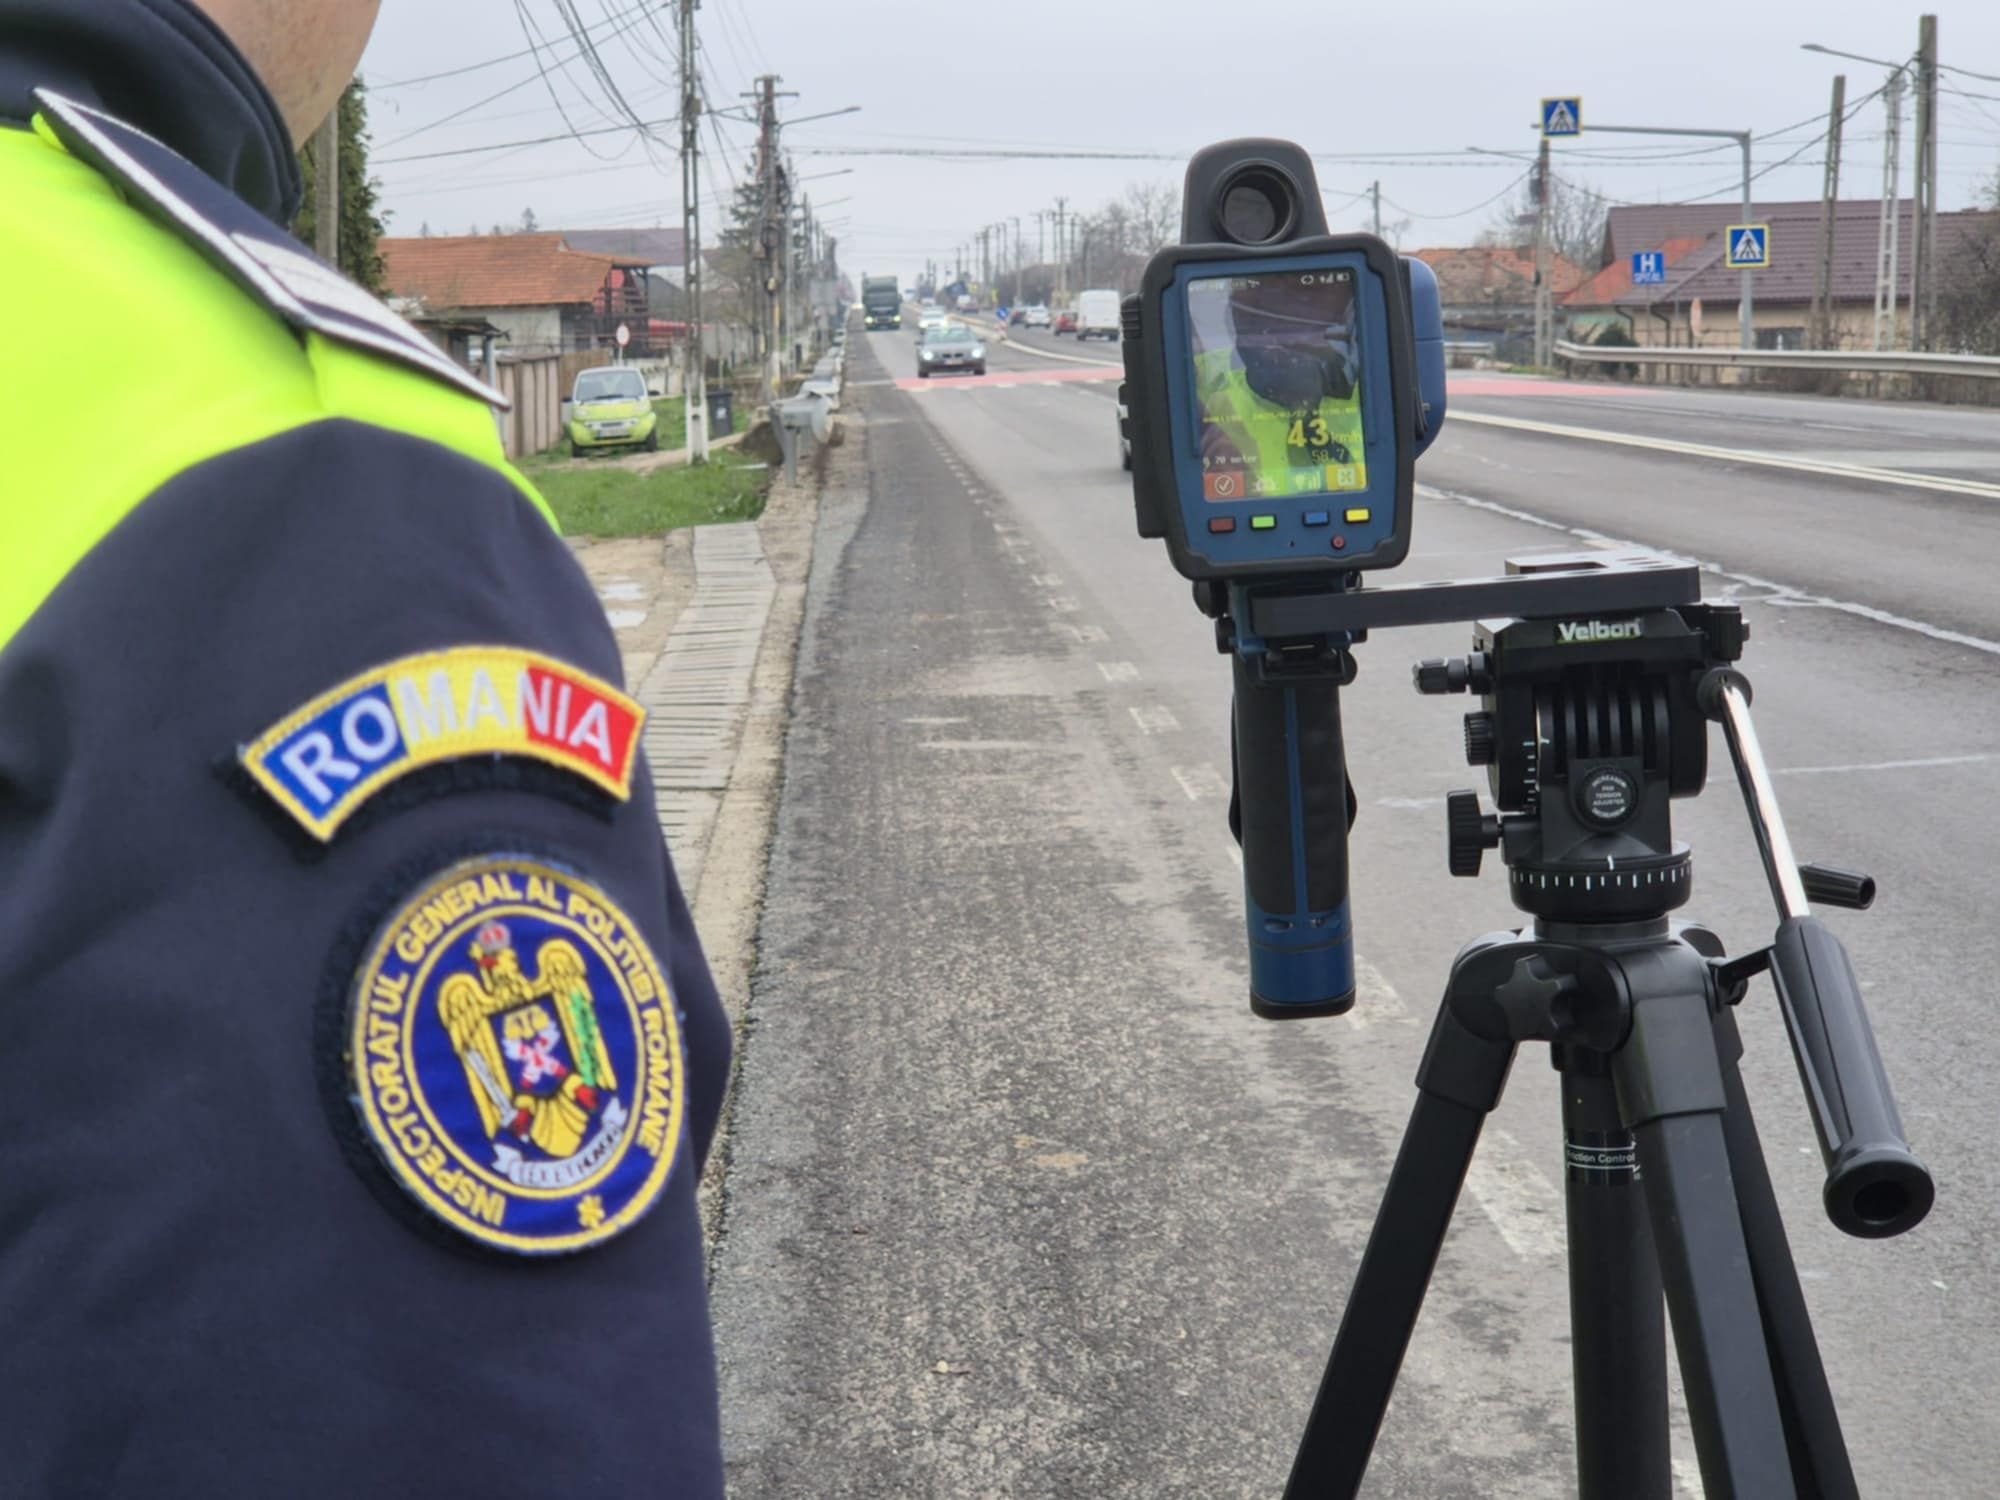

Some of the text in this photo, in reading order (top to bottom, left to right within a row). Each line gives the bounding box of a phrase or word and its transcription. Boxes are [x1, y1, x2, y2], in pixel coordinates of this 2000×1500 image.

[1641, 254, 1655, 272] H
[1288, 418, 1328, 447] 43
[1558, 620, 1642, 641] Velbon
[281, 669, 612, 805] ROMANIA
[527, 875, 563, 910] AL
[395, 873, 523, 963] GENERAL
[368, 973, 506, 1226] INSPECTORATUL
[1598, 1152, 1636, 1164] Control
